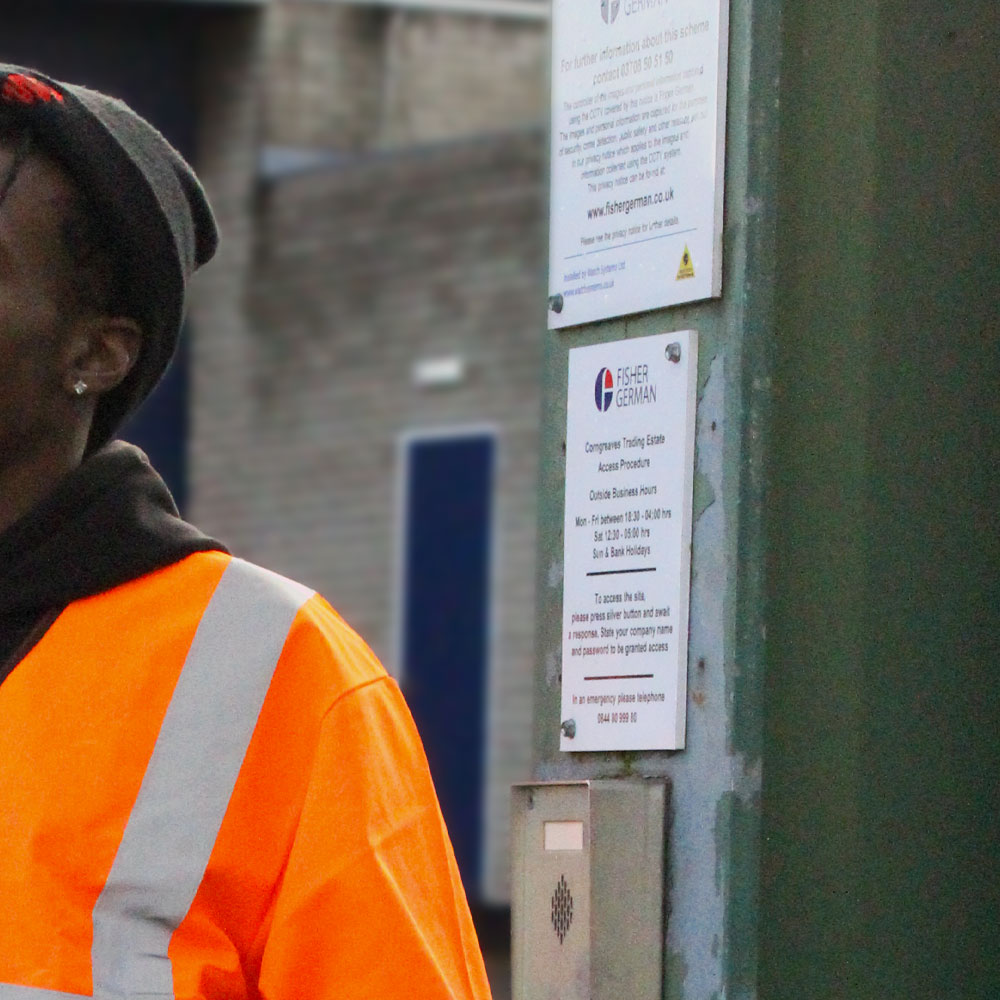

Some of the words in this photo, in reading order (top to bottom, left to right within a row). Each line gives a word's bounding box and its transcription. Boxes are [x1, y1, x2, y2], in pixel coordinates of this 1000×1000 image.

[560, 59, 573, 72] For
[574, 52, 598, 69] further
[599, 40, 640, 62] information
[641, 32, 663, 50] about
[664, 27, 678, 43] this
[680, 20, 710, 38] scheme
[593, 66, 619, 85] contact
[643, 55, 652, 70] 50
[665, 50, 674, 64] 50
[587, 187, 674, 220] www.fishergerman.co.uk
[617, 364, 648, 386] FISHER
[616, 384, 656, 407] GERMAN
[623, 436, 645, 449] Trading
[646, 434, 665, 446] Estate
[598, 462, 619, 472] Access
[620, 458, 650, 471] Procedure
[589, 489, 611, 501] Outside
[613, 486, 638, 499] Business
[640, 484, 657, 496] Hours
[575, 516, 587, 527] Mon
[601, 513, 623, 524] between
[662, 508, 671, 519] hrs
[594, 531, 603, 542] Sat
[605, 529, 619, 541] 12:30
[641, 527, 650, 538] hrs
[593, 548, 603, 559] Sun
[605, 547, 609, 558] &
[611, 546, 624, 557] Bank
[626, 544, 651, 558] Holidays
[595, 593, 602, 604] To
[603, 594, 622, 604] access
[624, 592, 632, 602] the
[572, 612, 589, 626] please
[590, 612, 605, 624] press
[607, 609, 622, 620] silver
[623, 608, 641, 619] button
[643, 606, 654, 618] and
[655, 606, 670, 617] await
[600, 627, 614, 638] State
[616, 628, 628, 639] your
[630, 626, 655, 638] company
[657, 626, 673, 635] name
[572, 646, 581, 656] and
[583, 644, 609, 657] password
[610, 644, 615, 654] to
[617, 643, 624, 653] be
[625, 642, 647, 656] granted
[648, 643, 668, 652] access
[572, 694, 577, 704] In
[579, 696, 585, 704] an
[587, 695, 616, 706] emergency
[617, 692, 635, 705] please
[637, 691, 665, 704] telephone
